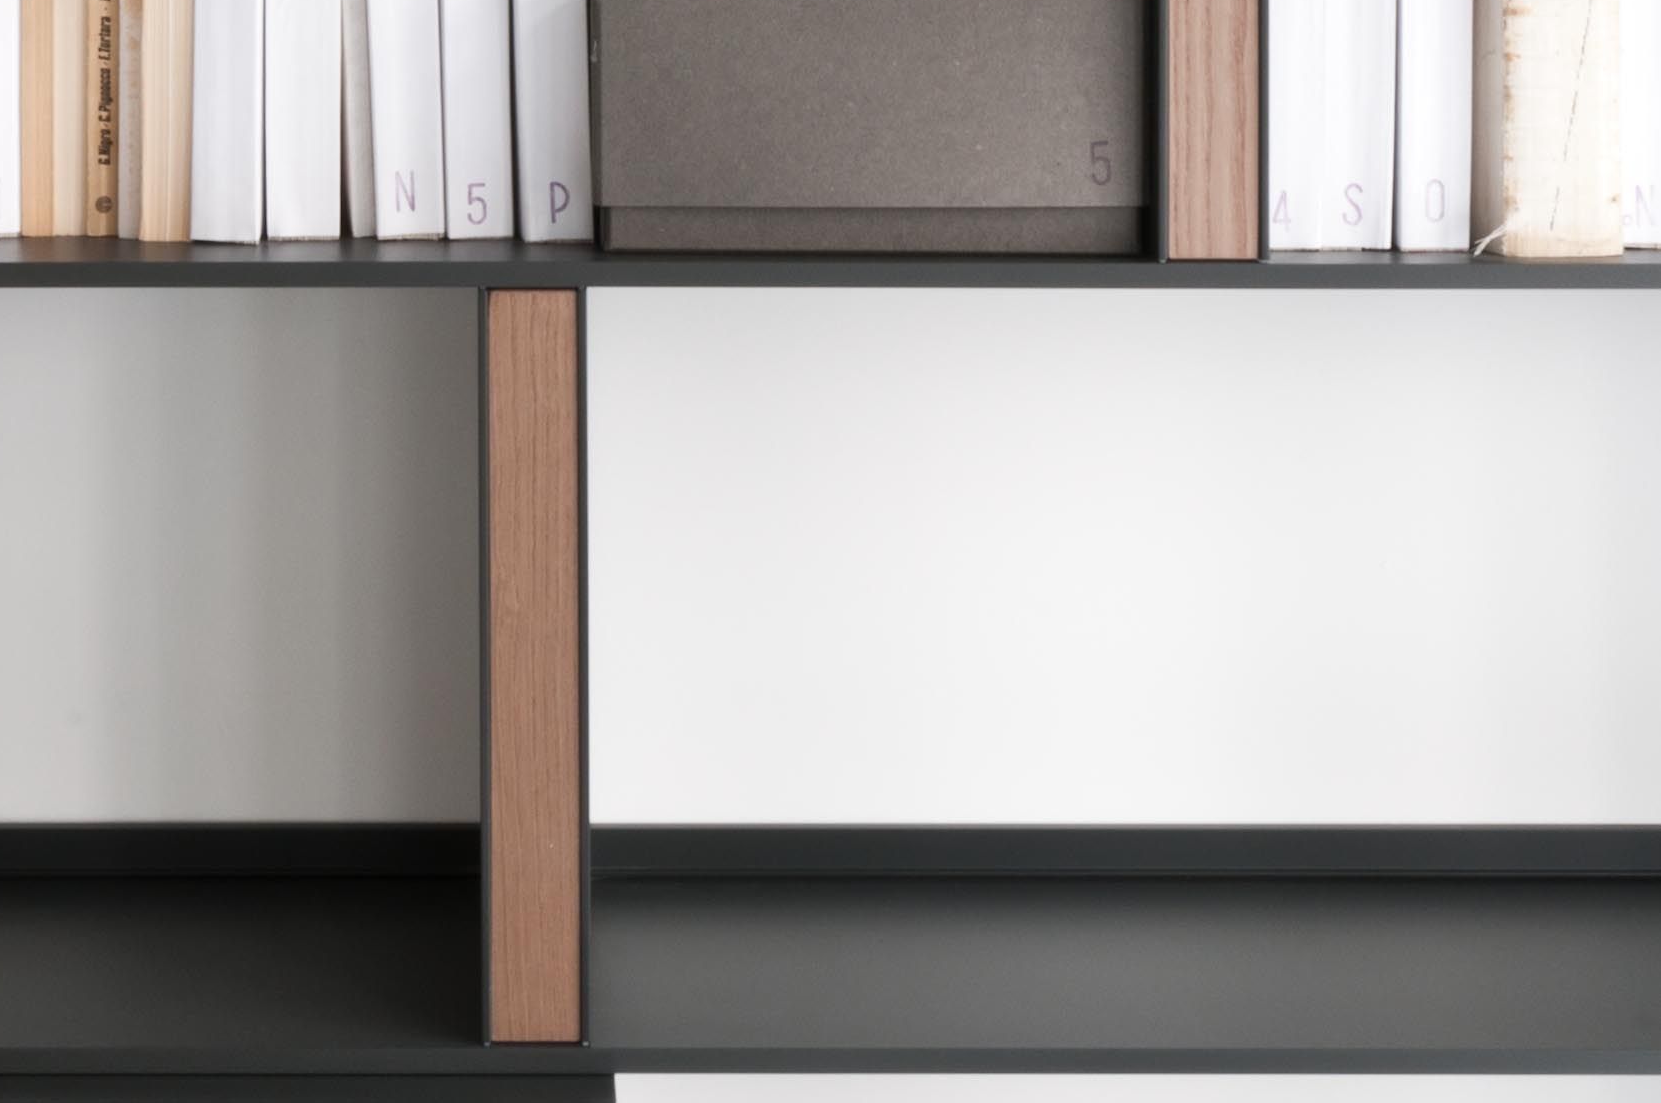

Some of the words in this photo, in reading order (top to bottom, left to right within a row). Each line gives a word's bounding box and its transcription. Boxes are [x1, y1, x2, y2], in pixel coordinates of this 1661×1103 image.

[1089, 139, 1112, 187] 5
[394, 169, 416, 214] N
[466, 182, 488, 226] 5
[549, 180, 571, 225] P
[1341, 182, 1365, 227] S
